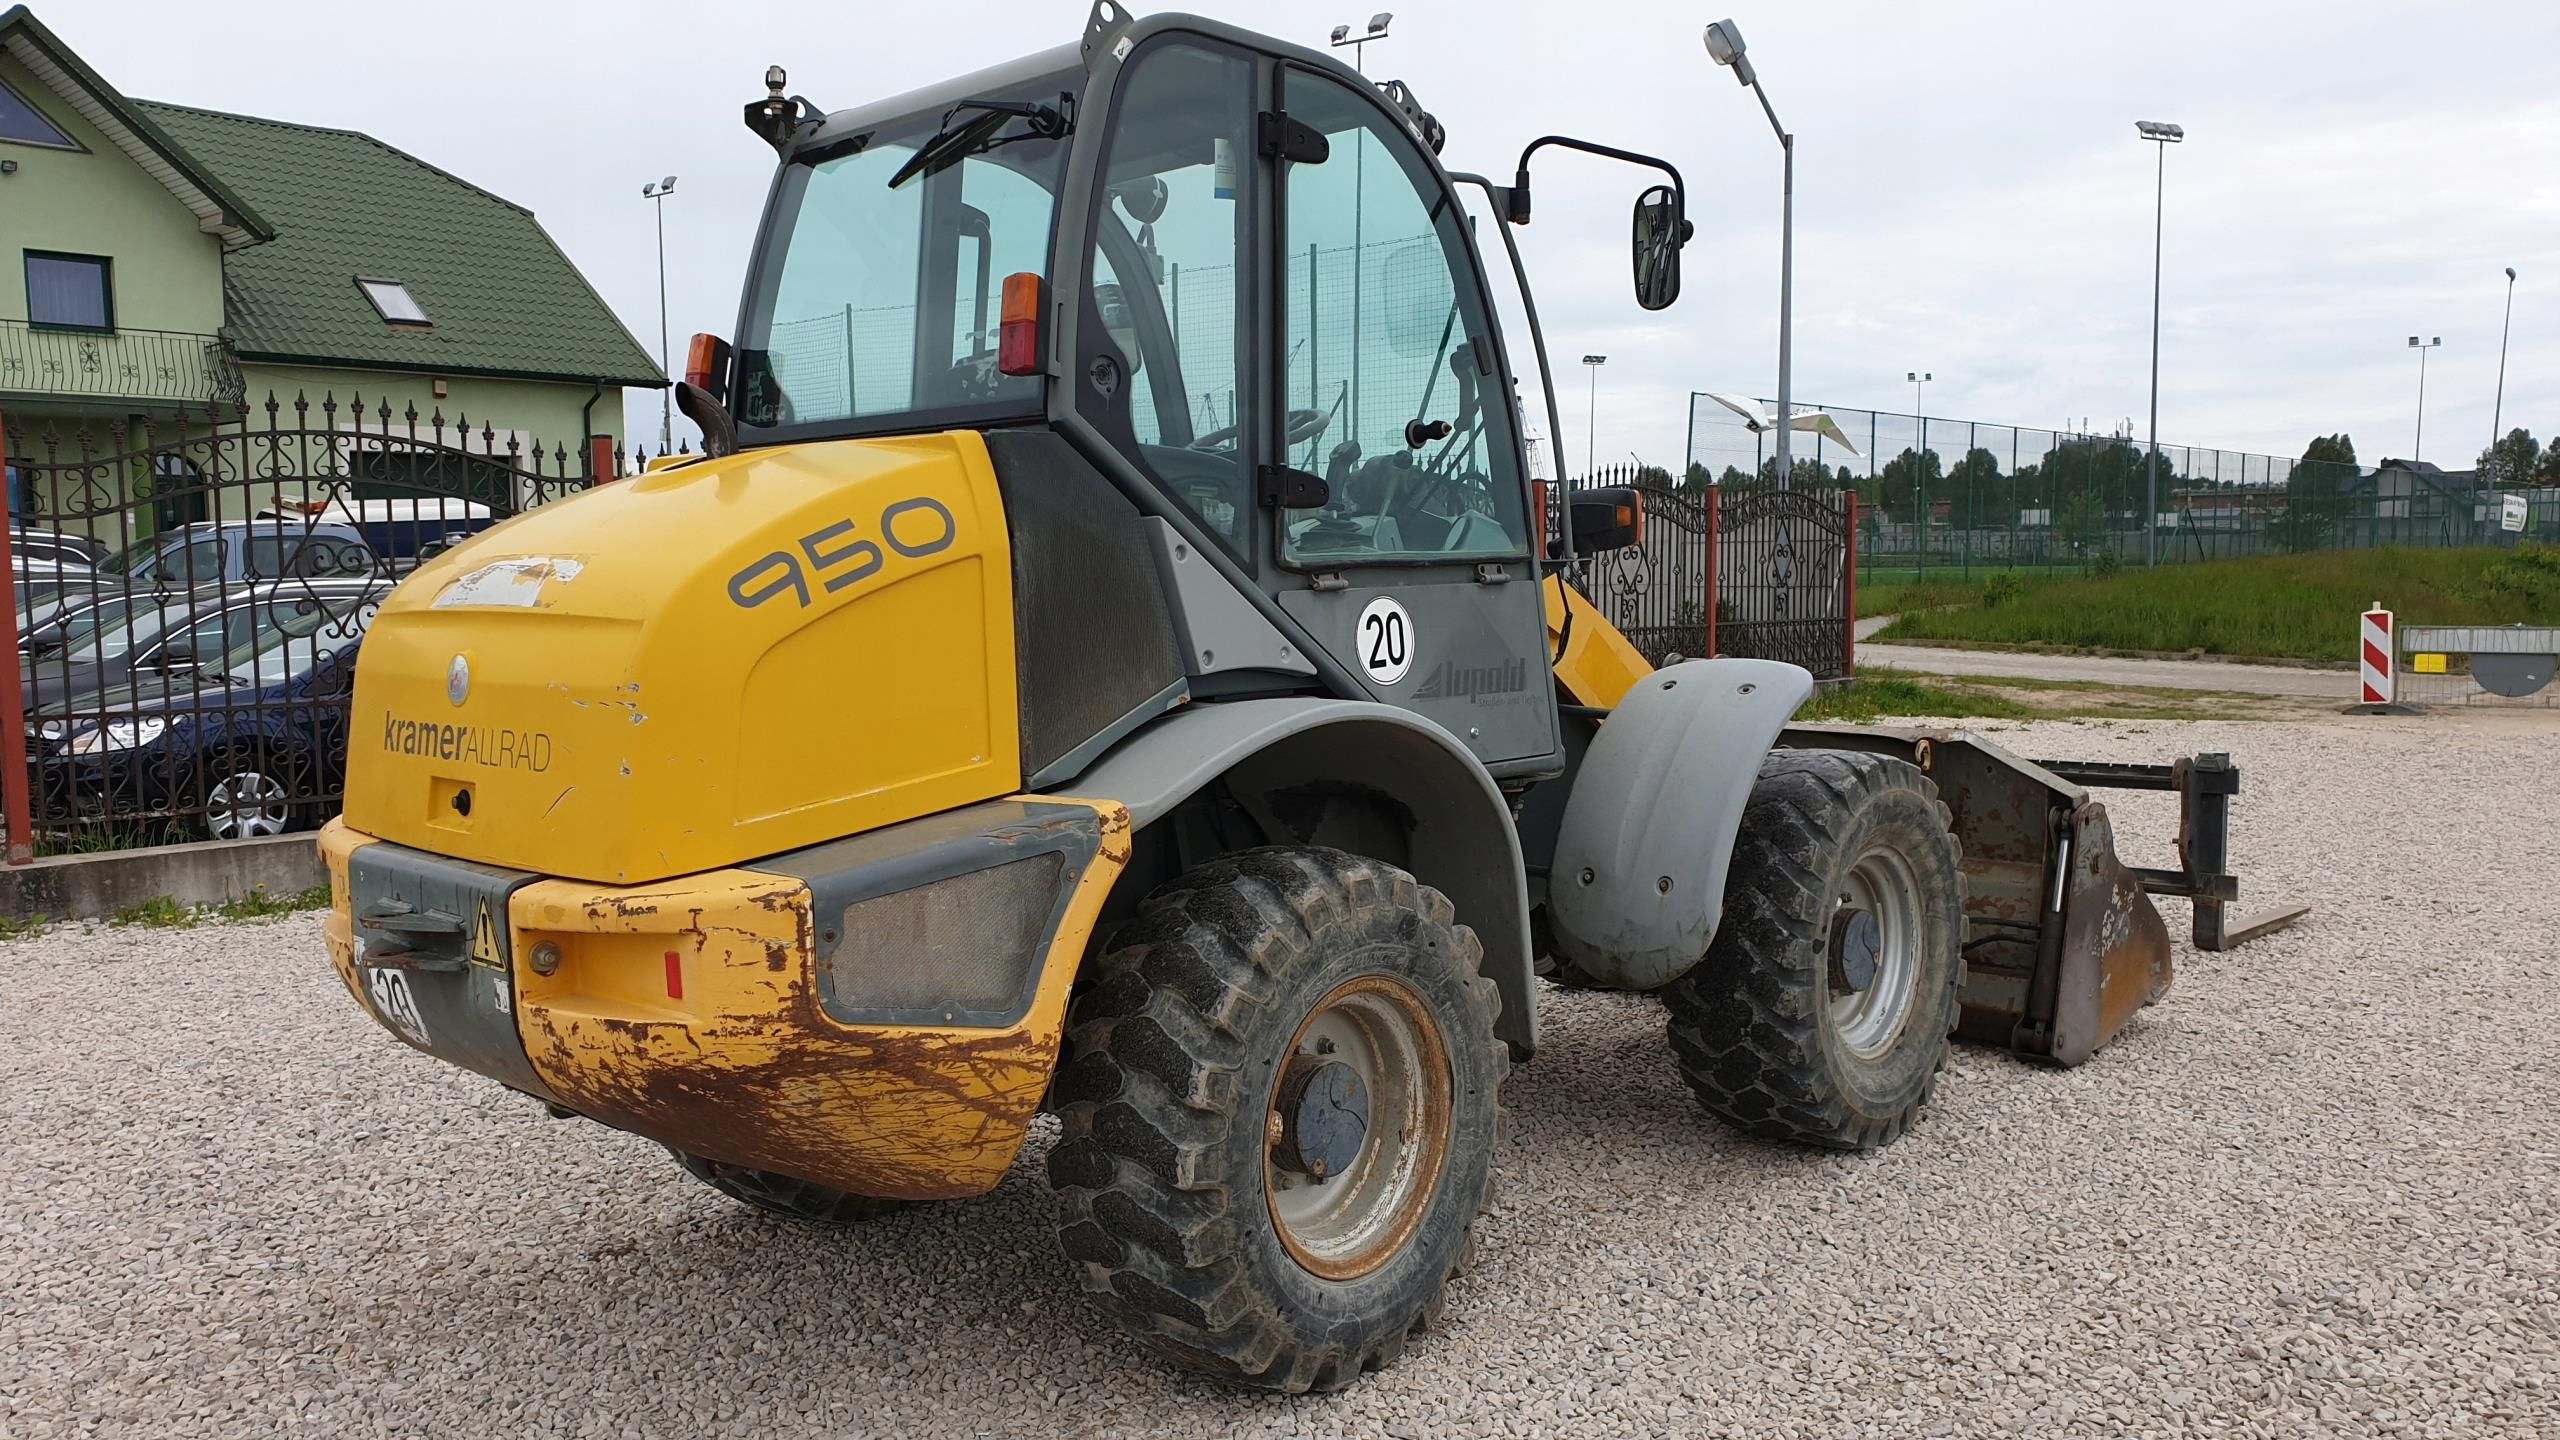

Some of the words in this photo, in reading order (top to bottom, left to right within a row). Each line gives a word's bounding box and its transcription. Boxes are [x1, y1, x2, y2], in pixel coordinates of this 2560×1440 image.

[727, 496, 955, 609] 950
[1366, 611, 1405, 669] 20
[1446, 657, 1525, 704] lupold
[384, 710, 551, 773] kramerALLRAD
[376, 967, 422, 1034] 20
